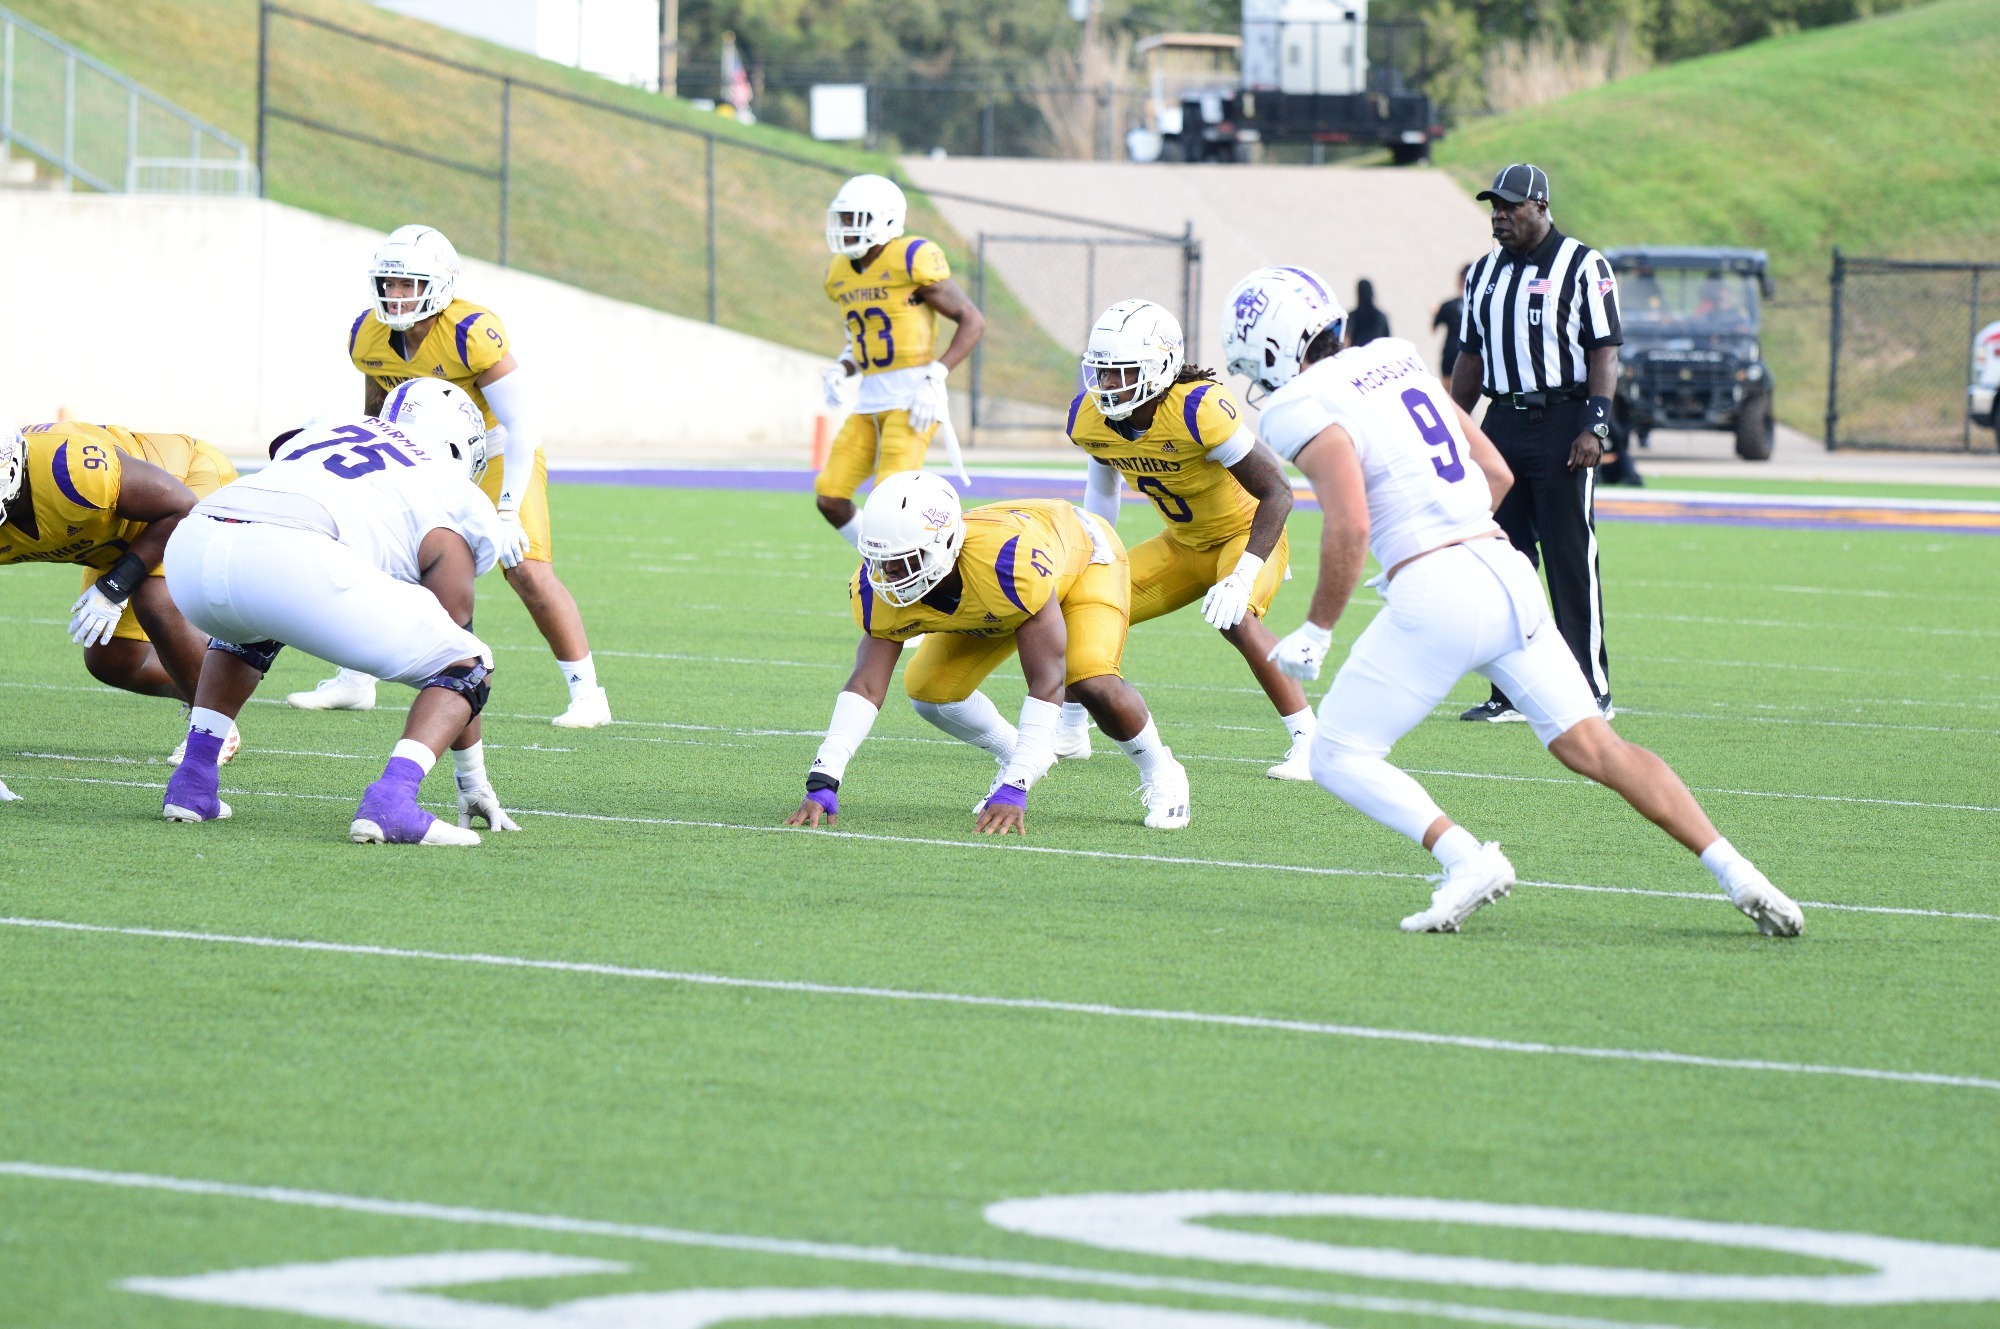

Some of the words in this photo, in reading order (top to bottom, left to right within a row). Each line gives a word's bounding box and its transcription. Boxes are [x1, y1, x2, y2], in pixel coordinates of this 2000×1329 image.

[1529, 308, 1542, 326] U
[486, 327, 503, 348] 9
[847, 307, 894, 370] 33
[402, 402, 415, 413] 75
[1218, 398, 1237, 420] 0
[1401, 387, 1466, 484] 9
[280, 424, 417, 480] 75
[1137, 475, 1194, 523] 0
[1030, 547, 1054, 578] 47
